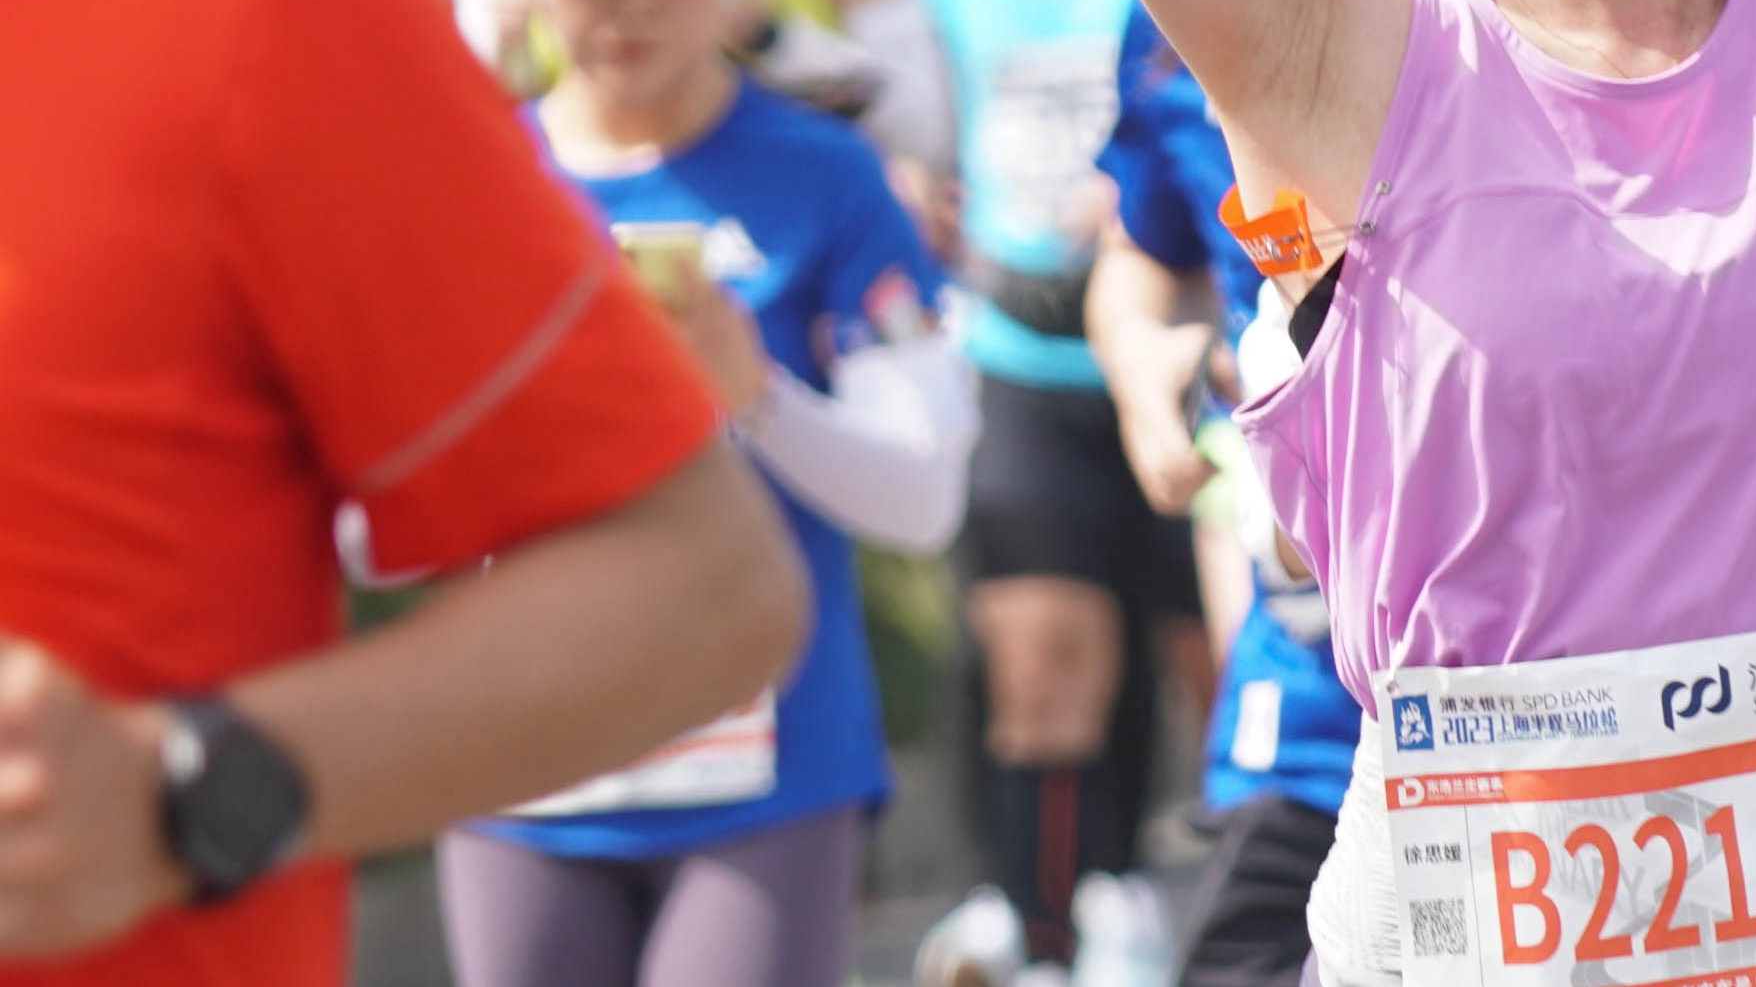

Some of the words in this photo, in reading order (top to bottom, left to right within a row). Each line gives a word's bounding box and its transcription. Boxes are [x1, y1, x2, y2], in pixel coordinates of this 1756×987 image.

[1440, 692, 1515, 713] 浦发银行
[1522, 694, 1558, 712] SPD
[1561, 686, 1616, 710] BANK
